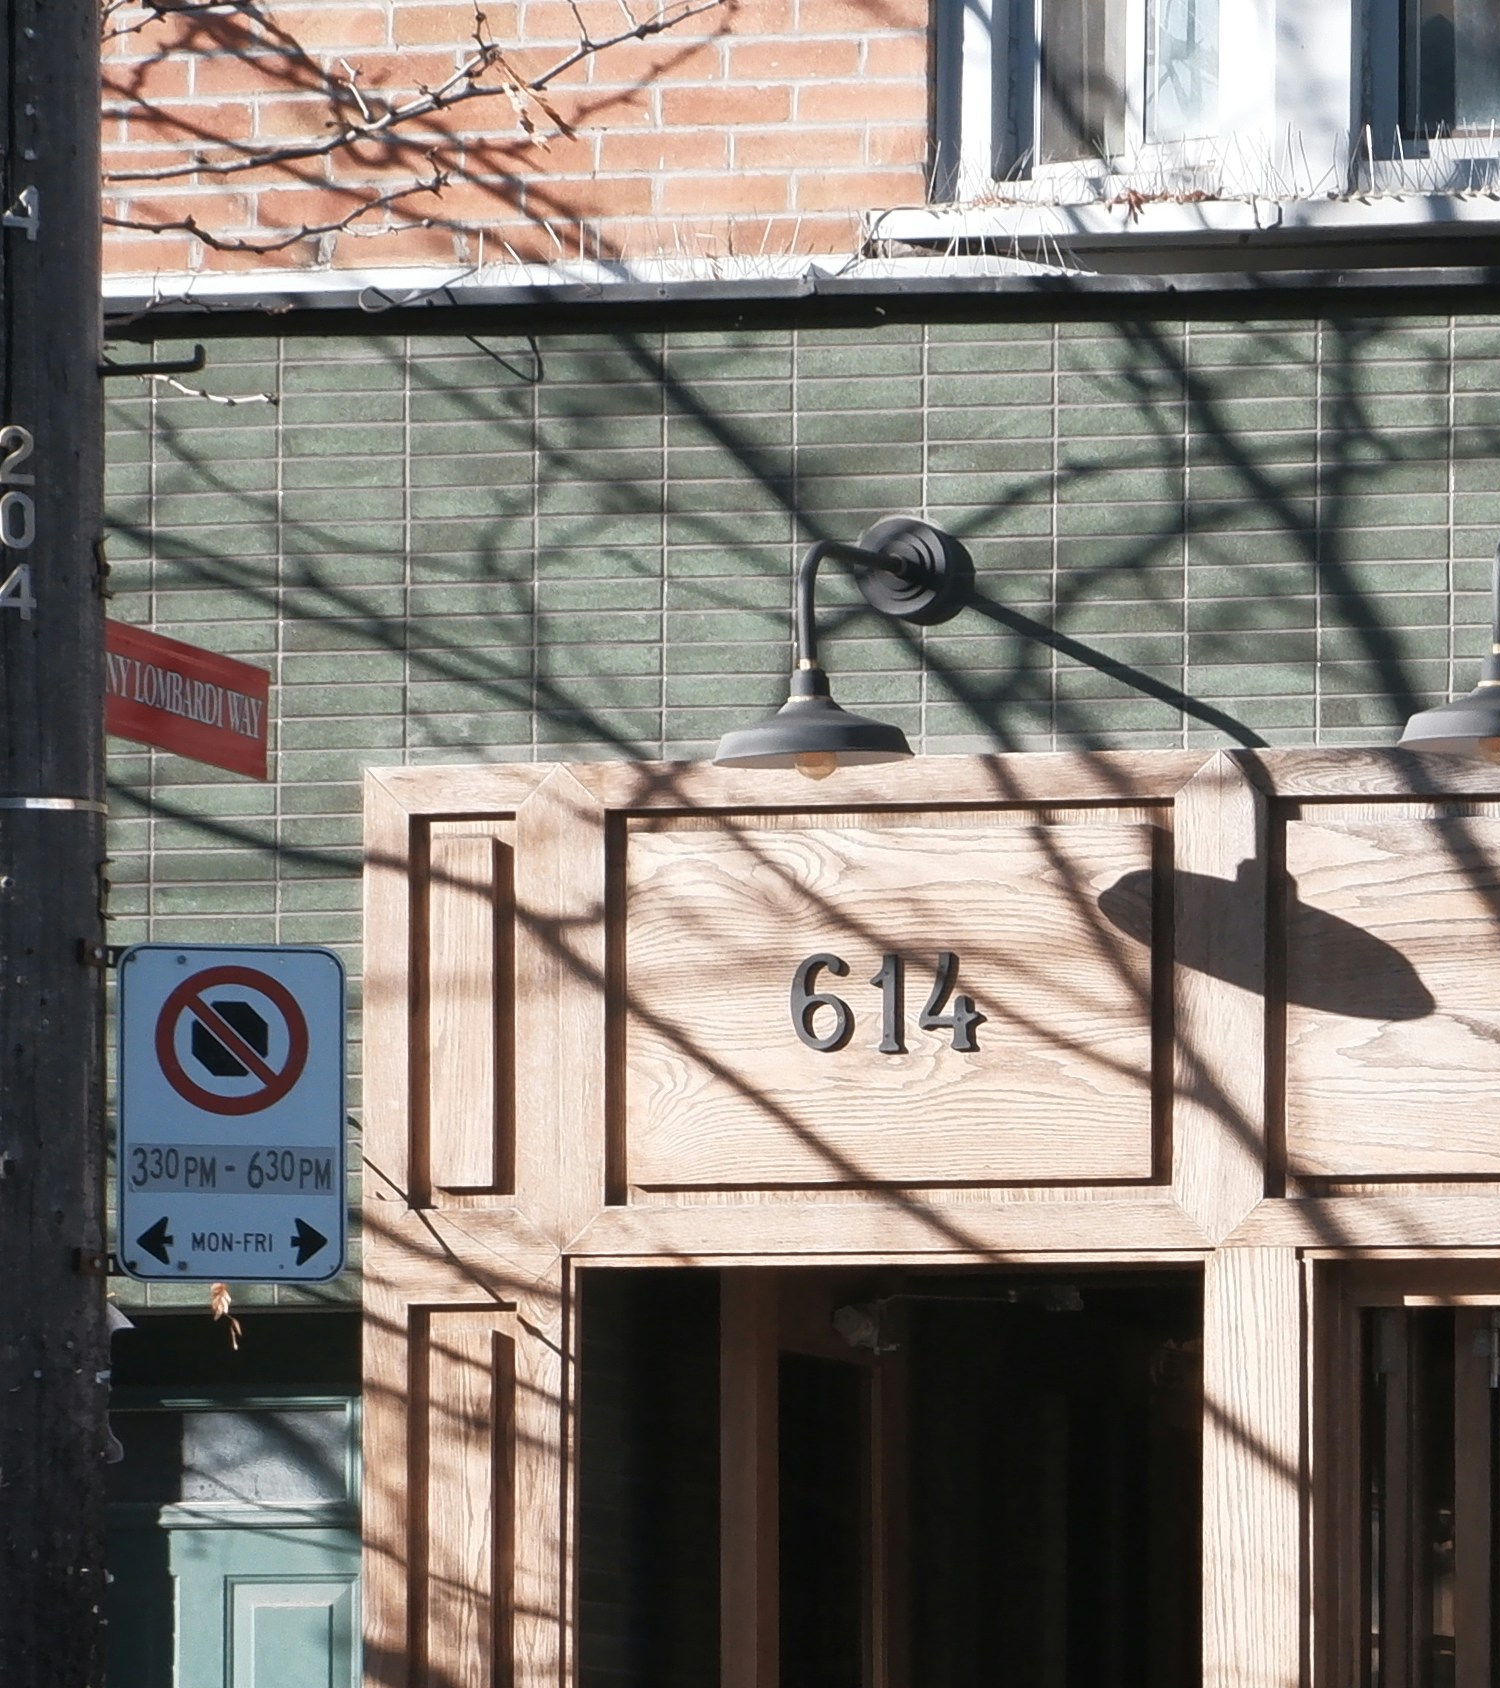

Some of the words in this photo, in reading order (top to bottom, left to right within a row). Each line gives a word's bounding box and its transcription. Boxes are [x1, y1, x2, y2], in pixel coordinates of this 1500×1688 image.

[134, 661, 223, 729] LOMBARDI
[227, 689, 263, 739] WAY
[790, 951, 987, 1053] 614
[184, 1156, 217, 1188] PM
[247, 1150, 295, 1189] 630
[300, 1158, 332, 1190] PM
[191, 1231, 273, 1252] MON-FRI
